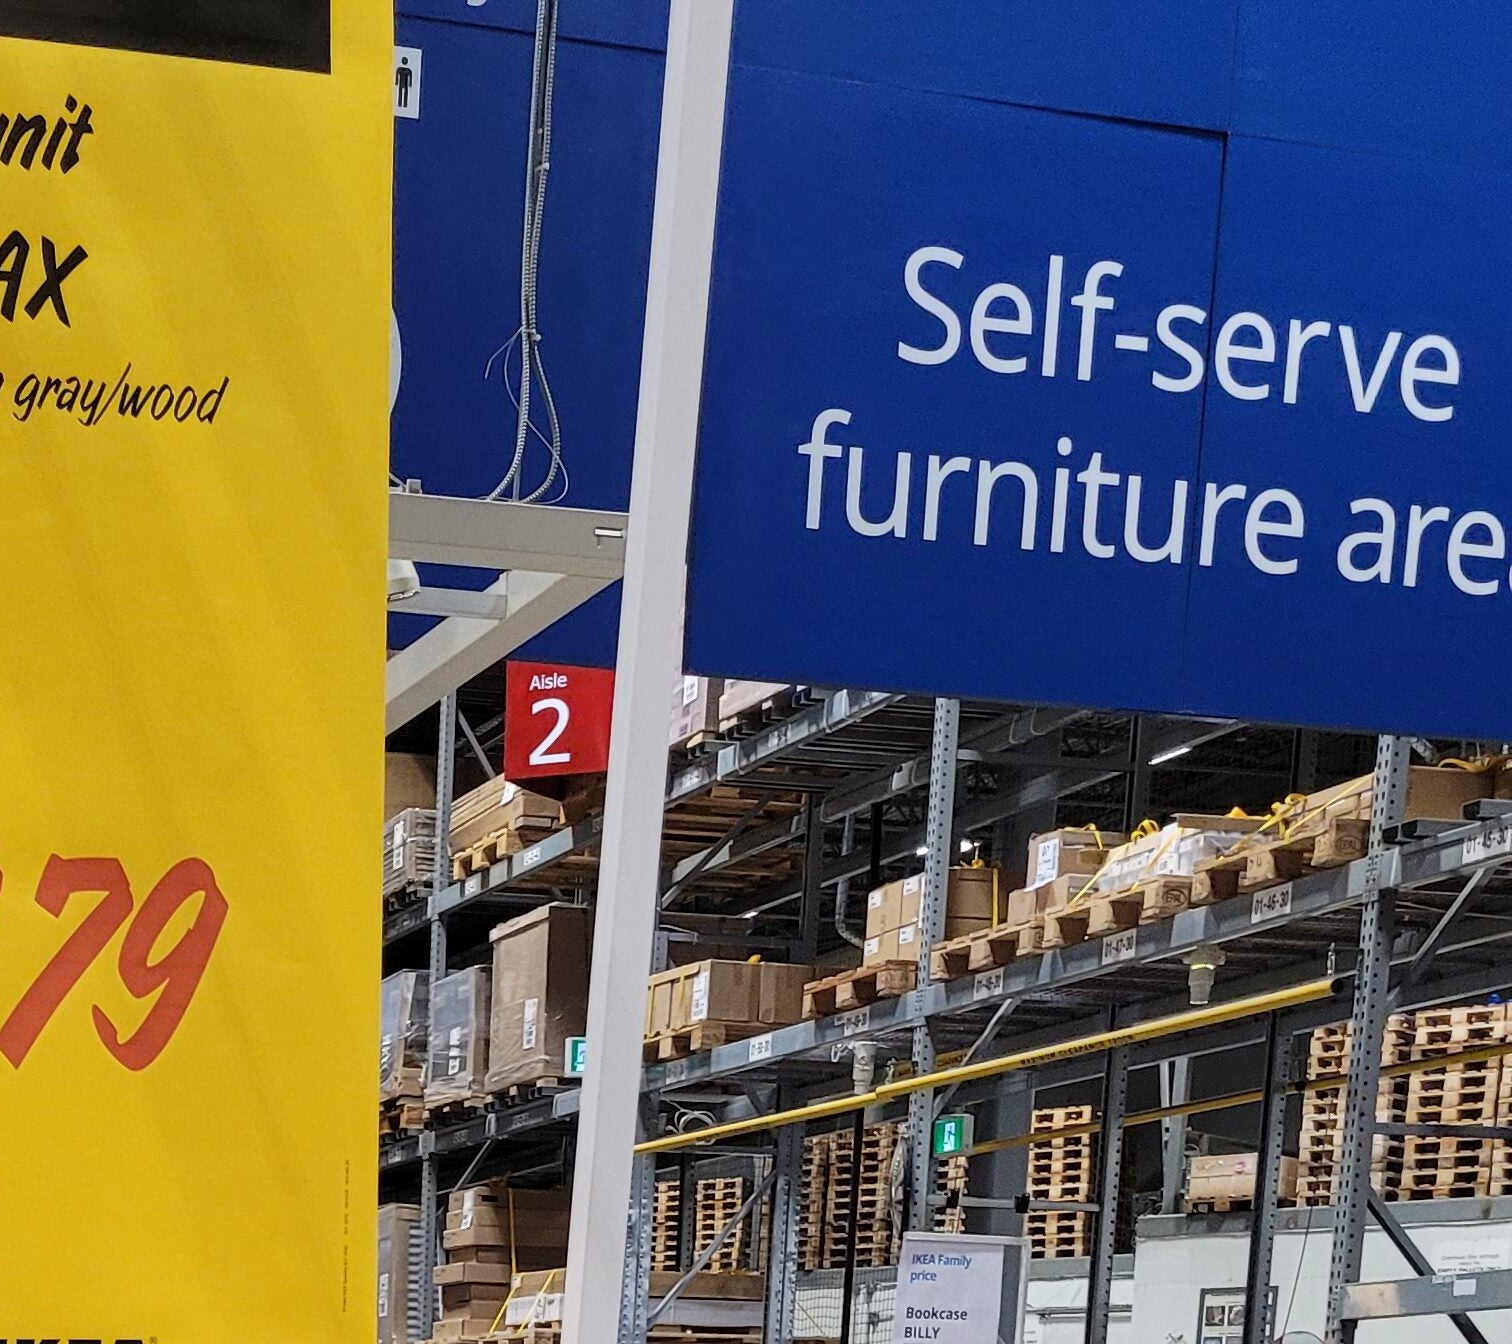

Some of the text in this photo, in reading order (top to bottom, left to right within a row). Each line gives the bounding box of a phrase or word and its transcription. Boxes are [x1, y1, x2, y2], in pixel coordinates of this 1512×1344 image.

[897, 247, 1461, 422] Self-serve
[12, 361, 229, 427] gray/wood
[798, 408, 1512, 598] furniture are
[529, 672, 568, 691] Aisle
[528, 698, 571, 766] 2
[912, 1254, 972, 1269] IKEA Family
[910, 1270, 937, 1283] price
[906, 1307, 968, 1320] Bookcase
[904, 1327, 940, 1339] BILLY
